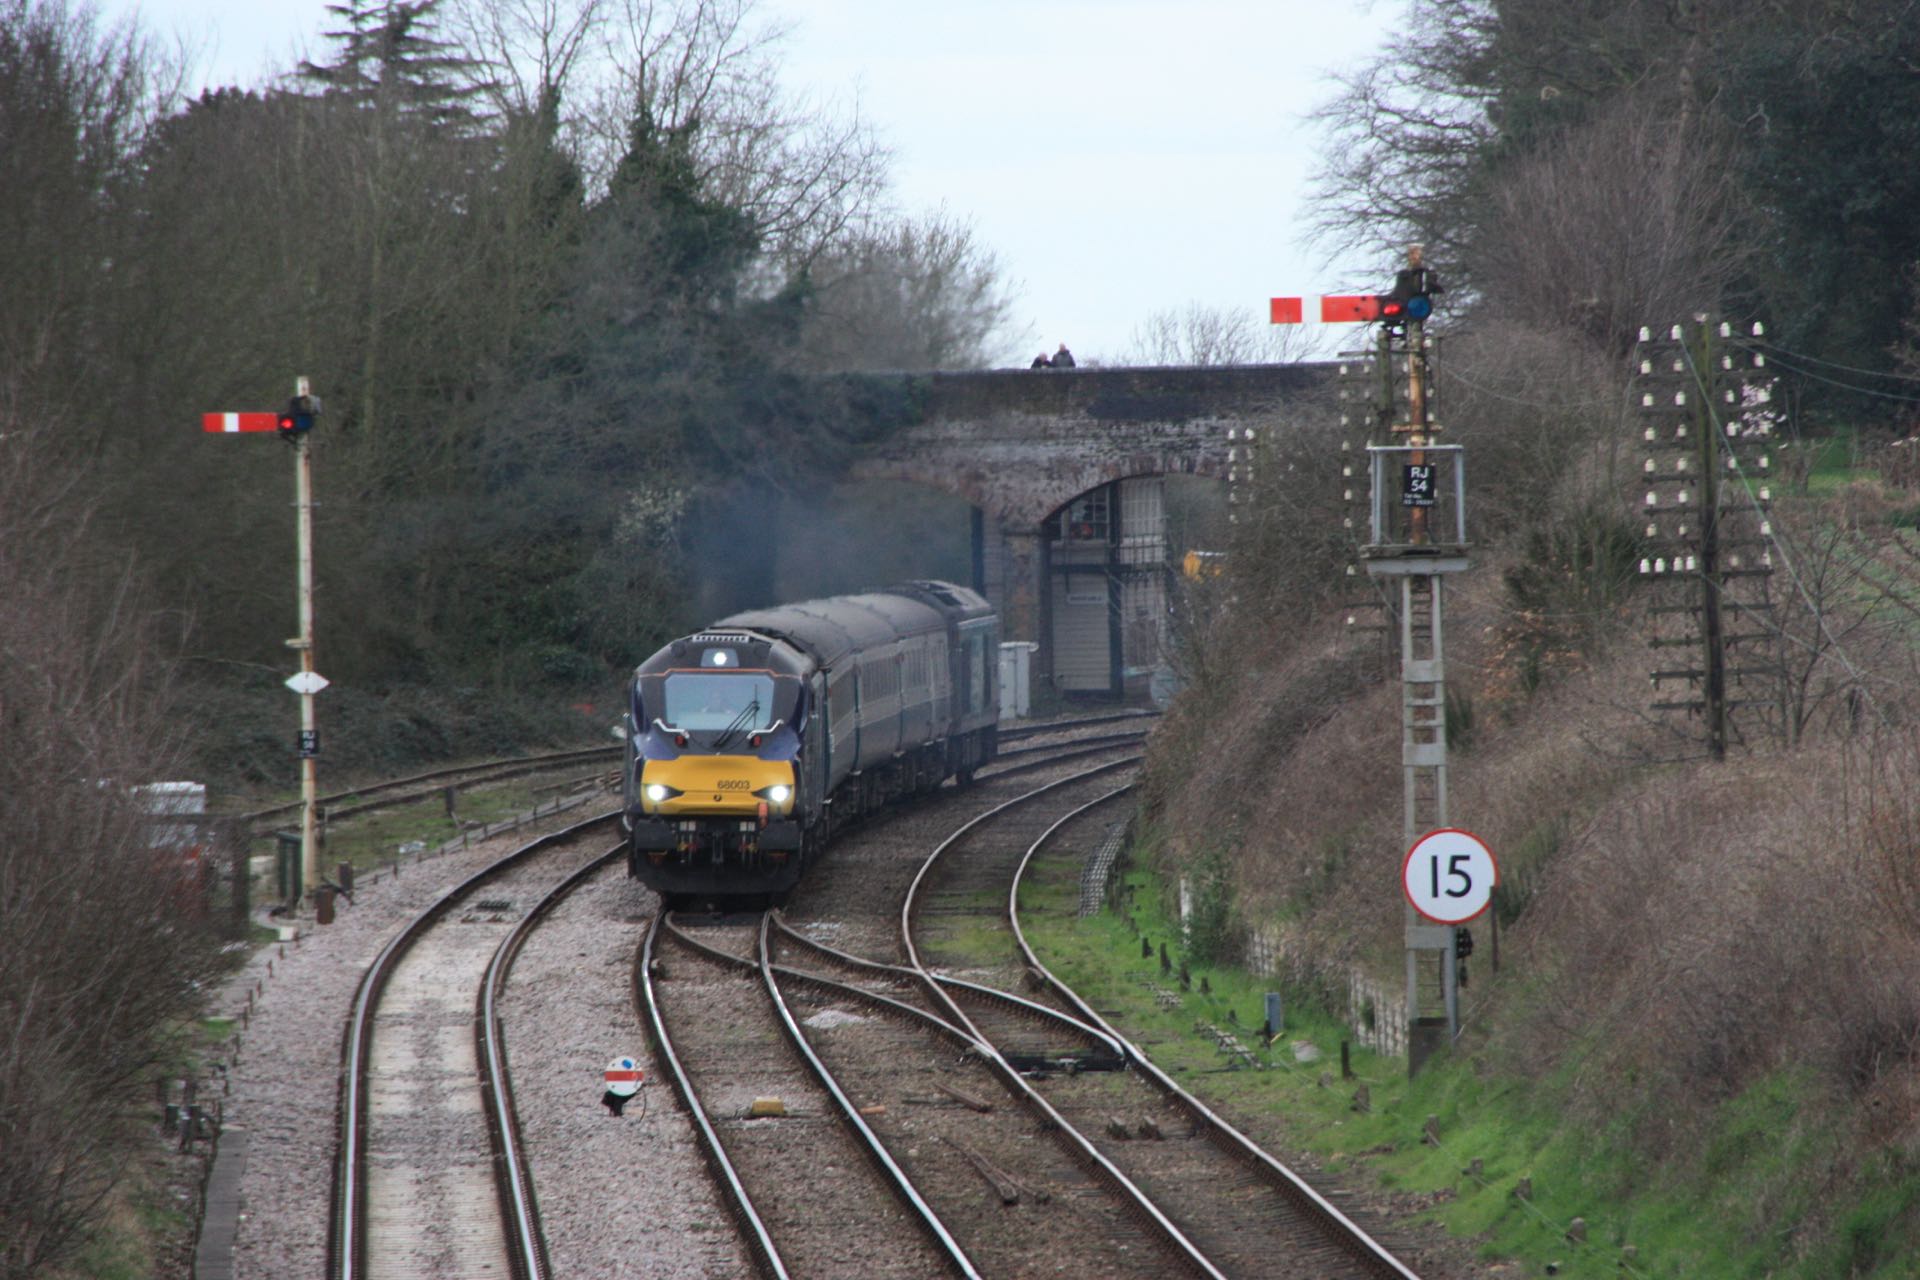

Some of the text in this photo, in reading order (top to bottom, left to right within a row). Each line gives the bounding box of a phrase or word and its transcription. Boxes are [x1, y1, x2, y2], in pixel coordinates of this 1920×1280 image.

[1411, 466, 1429, 479] RJ
[1411, 479, 1428, 492] 54
[717, 779, 751, 790] 68003
[1431, 854, 1472, 898] 15
